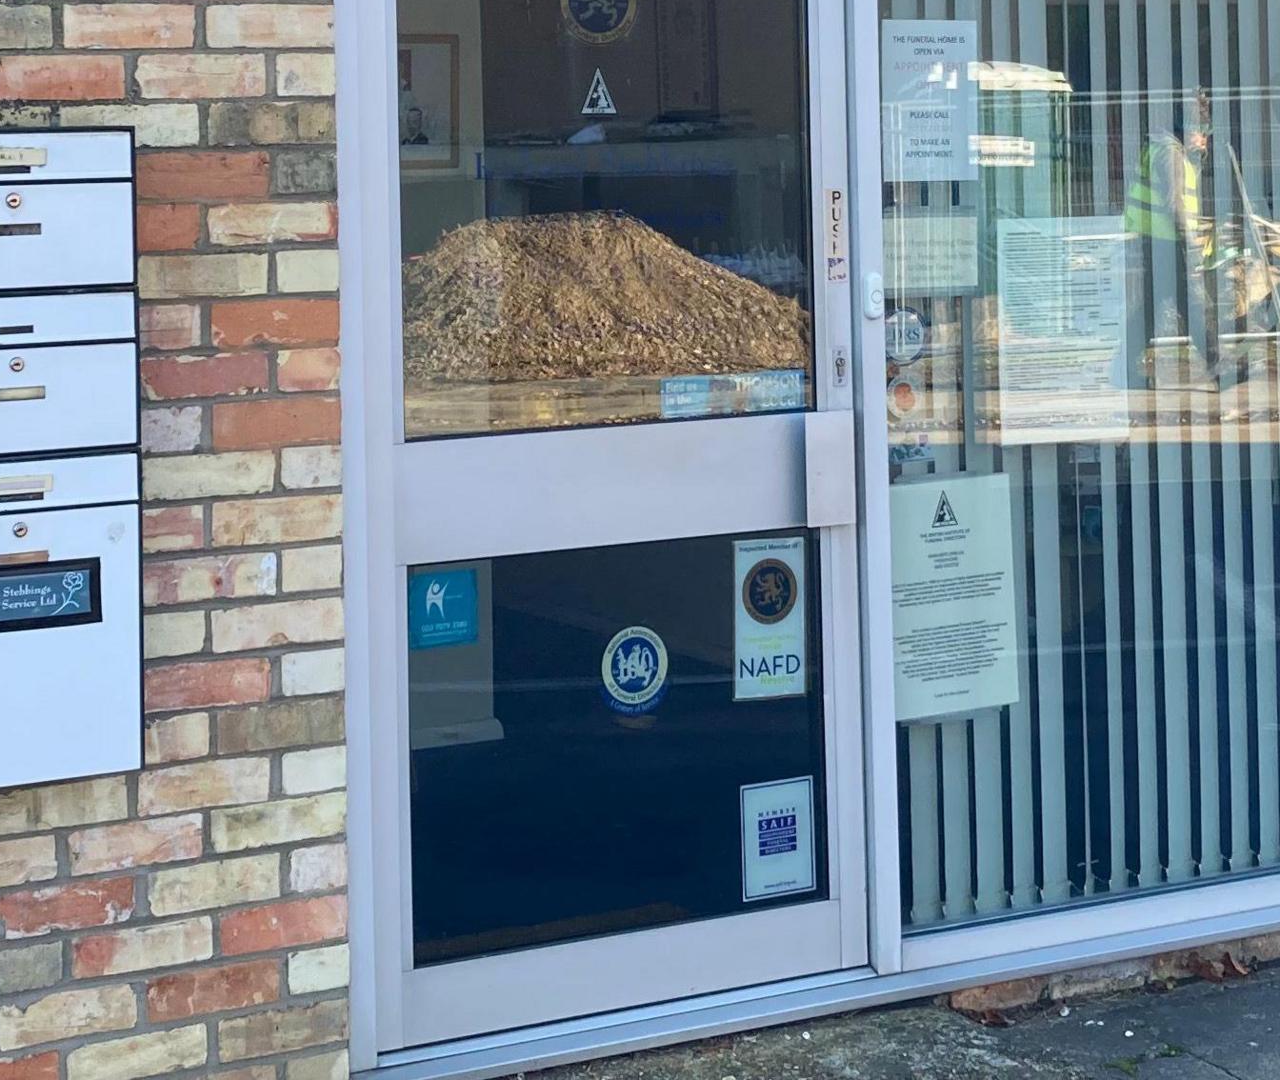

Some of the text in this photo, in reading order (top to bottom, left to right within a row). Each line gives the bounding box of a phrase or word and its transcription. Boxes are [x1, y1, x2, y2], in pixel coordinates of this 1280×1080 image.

[893, 35, 966, 44] THE FUNERAL HOME IS
[913, 47, 945, 56] OPEN VIA
[895, 61, 965, 72] APPOINTENT
[933, 111, 950, 119] CALL
[2, 583, 52, 599] Stebbings
[1, 599, 38, 610] Service
[40, 594, 57, 606] Ltd
[739, 654, 801, 679] NAFD
[761, 817, 794, 831] SAIF
